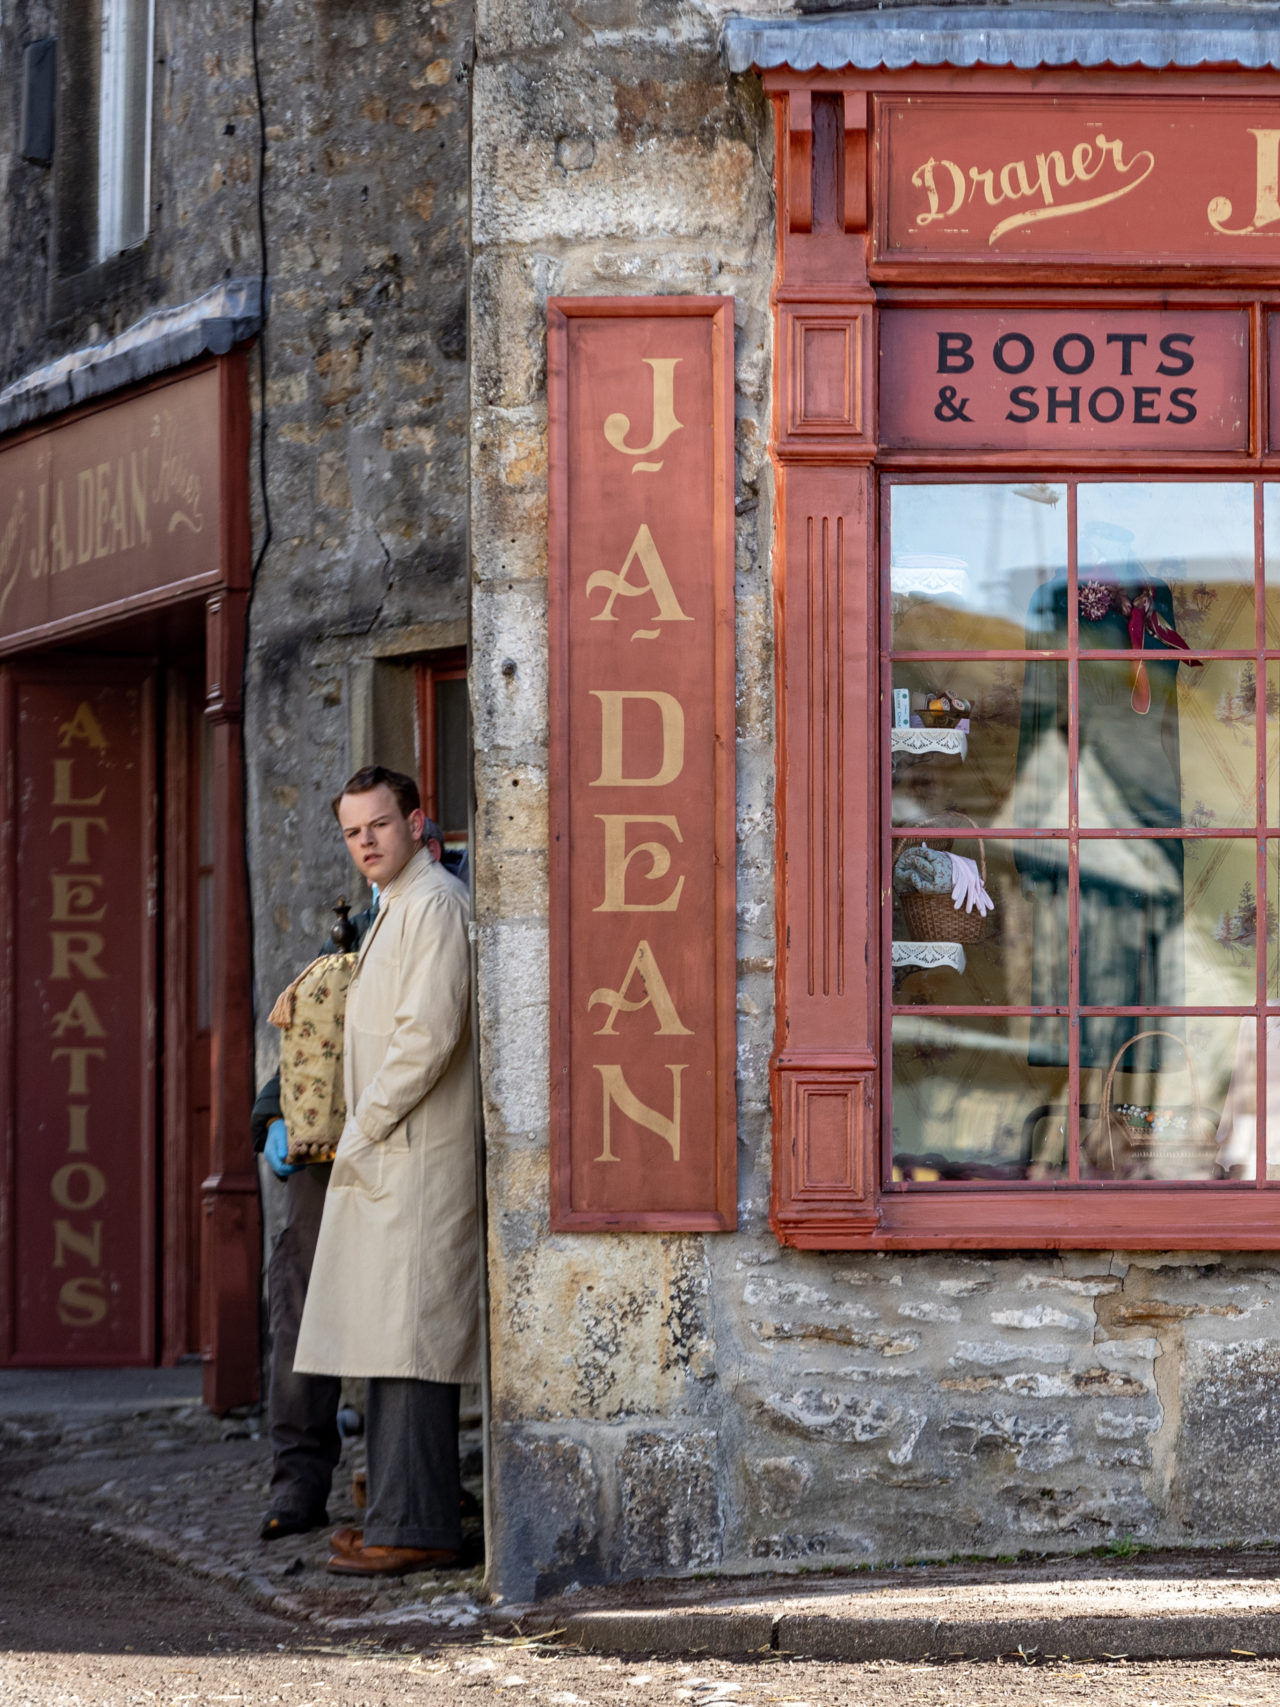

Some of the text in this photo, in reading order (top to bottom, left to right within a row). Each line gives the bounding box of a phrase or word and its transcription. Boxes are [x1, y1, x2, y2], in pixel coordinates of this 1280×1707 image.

[911, 133, 1154, 245] Draper
[935, 331, 1196, 376] BOOTS
[933, 385, 1198, 424] & SHOES
[50, 700, 110, 1328] ALTERATIONS
